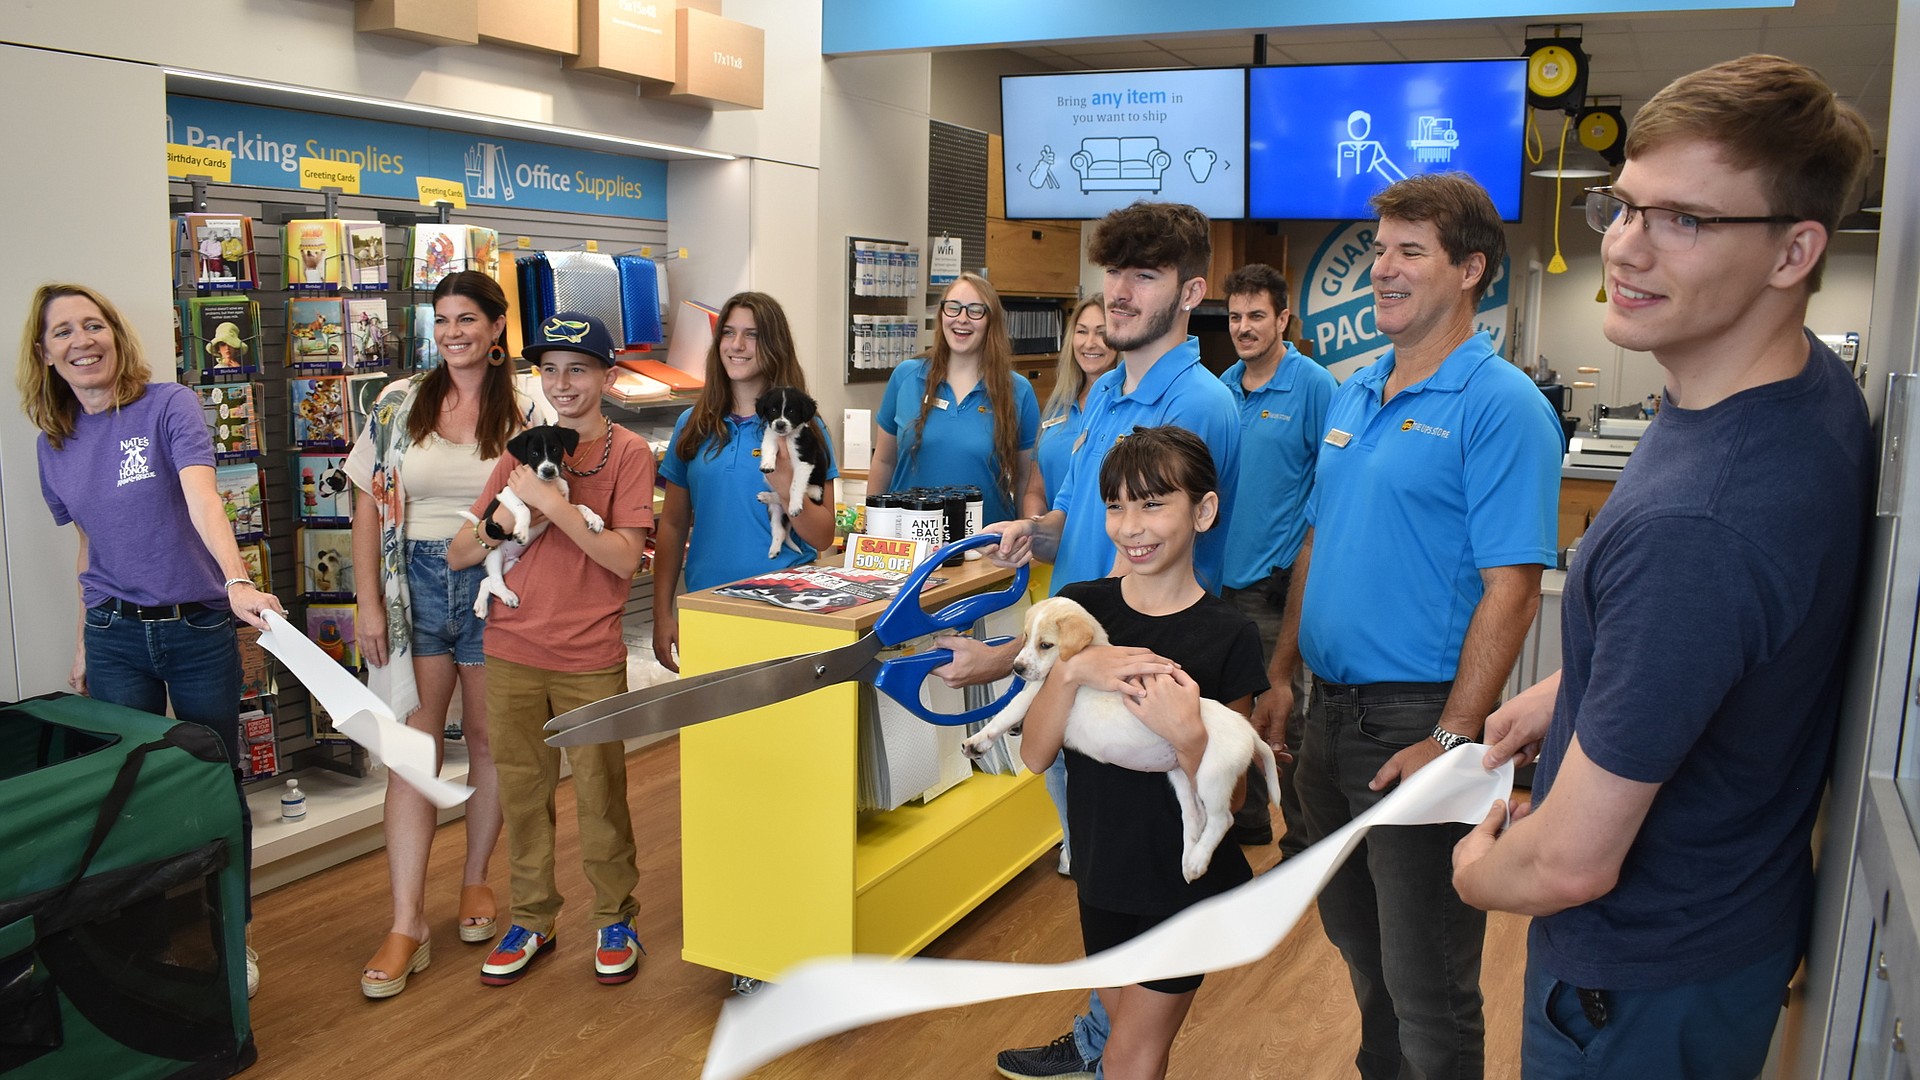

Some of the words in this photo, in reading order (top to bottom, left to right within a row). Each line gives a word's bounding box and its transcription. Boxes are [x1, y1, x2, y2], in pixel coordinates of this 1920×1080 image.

[713, 51, 743, 70] 17x11x8
[1057, 96, 1087, 108] Bring
[1091, 92, 1123, 109] any
[1127, 88, 1166, 104] item
[1172, 92, 1183, 103] in
[1072, 114, 1093, 126] you
[1097, 112, 1125, 122] want
[1128, 112, 1140, 121] to
[1142, 110, 1168, 124] ship
[186, 126, 298, 173] Packing
[305, 139, 404, 175] Supplies
[203, 157, 227, 169] Cards
[304, 169, 336, 183] Greeting
[337, 171, 356, 183] Cards
[515, 163, 571, 192] Office
[575, 170, 642, 202] Supplies
[420, 186, 447, 198] Greeting
[447, 188, 463, 198] Cards
[938, 245, 954, 255] Wifi
[1321, 228, 1374, 297] GUAR
[120, 436, 150, 451] NATE'S
[119, 465, 149, 480] HONOR
[912, 519, 939, 529] ANTI
[861, 539, 911, 557] SALE
[856, 553, 885, 570] 50%
[888, 557, 912, 572] OFF
